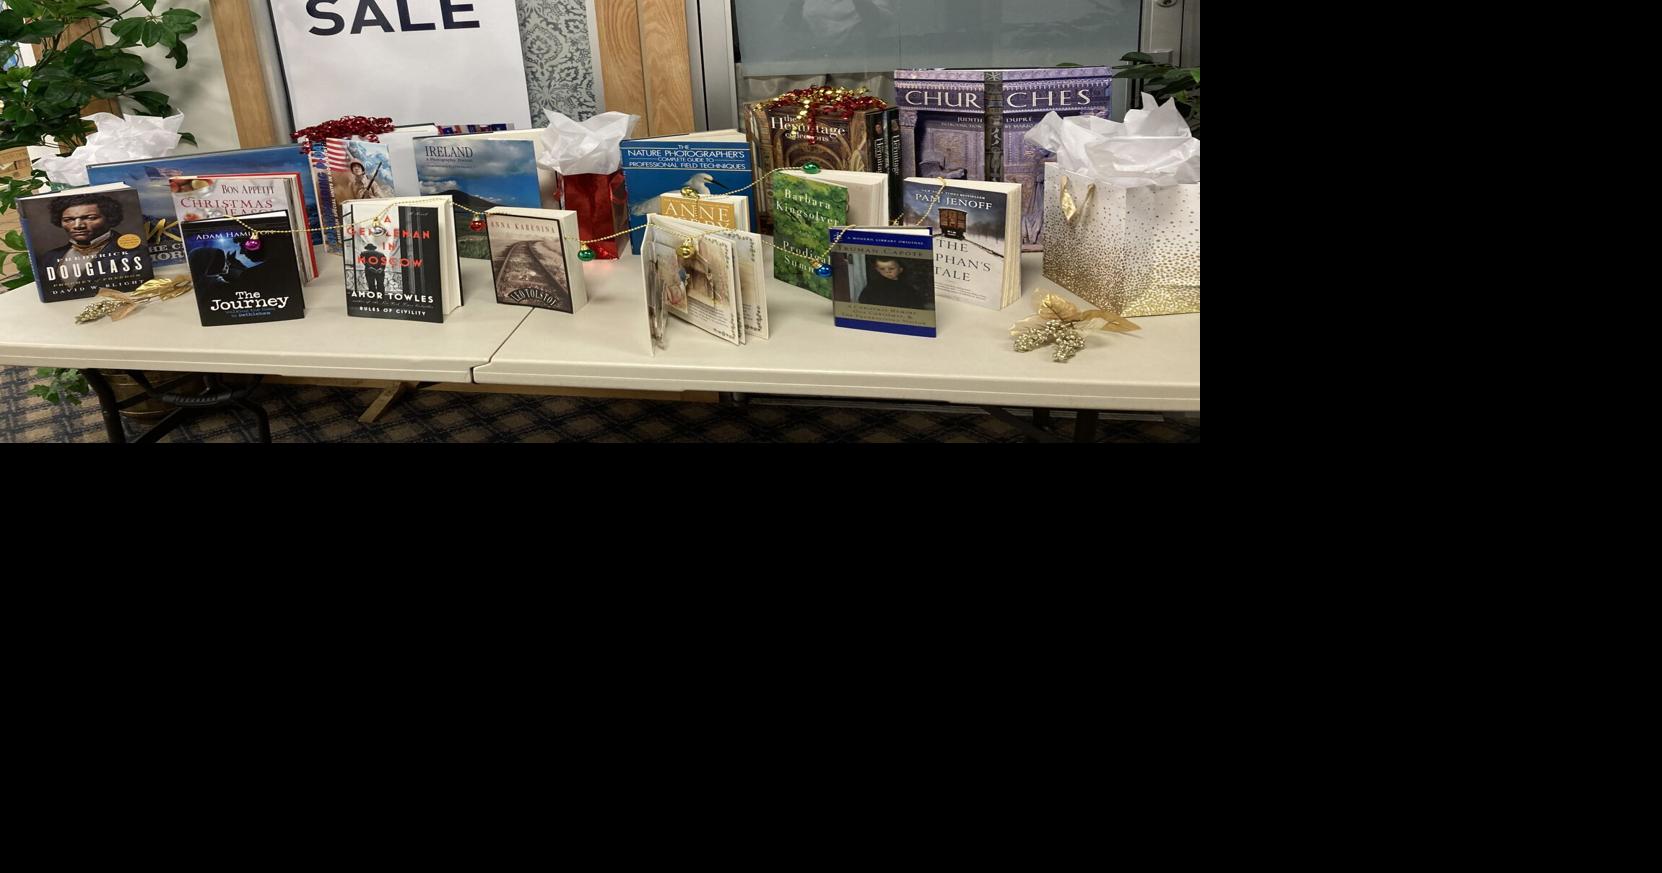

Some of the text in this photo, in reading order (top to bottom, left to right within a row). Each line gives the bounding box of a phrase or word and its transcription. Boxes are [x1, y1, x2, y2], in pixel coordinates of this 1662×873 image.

[305, 0, 481, 36] SALE
[905, 89, 1092, 109] CHUR CHES
[425, 146, 474, 158] IRELAND
[664, 150, 745, 159] PHOTOGRAPHER'S
[221, 185, 239, 194] BON
[180, 198, 273, 209] CHRISTMAS
[784, 189, 832, 209] Barbara
[915, 193, 992, 210] PAM JENOFF
[665, 202, 731, 222] ANNE
[776, 201, 841, 226] Kingsolver
[384, 215, 392, 223] A
[491, 221, 510, 229] ANNA
[383, 242, 397, 251] IN
[837, 245, 923, 257] TRUMAN CAPOTE
[937, 239, 968, 252] THE
[56, 251, 129, 263] FREDERICK
[357, 256, 423, 268] MOSCOW
[936, 253, 991, 272] PHAN'S
[46, 256, 143, 281] DOUGLASS
[936, 267, 970, 281] TALE
[52, 287, 85, 295] DAVID
[105, 280, 144, 288] BLIGHT
[235, 291, 261, 300] The
[351, 291, 434, 303] AMOR TOWLES
[210, 296, 289, 311] Journey
